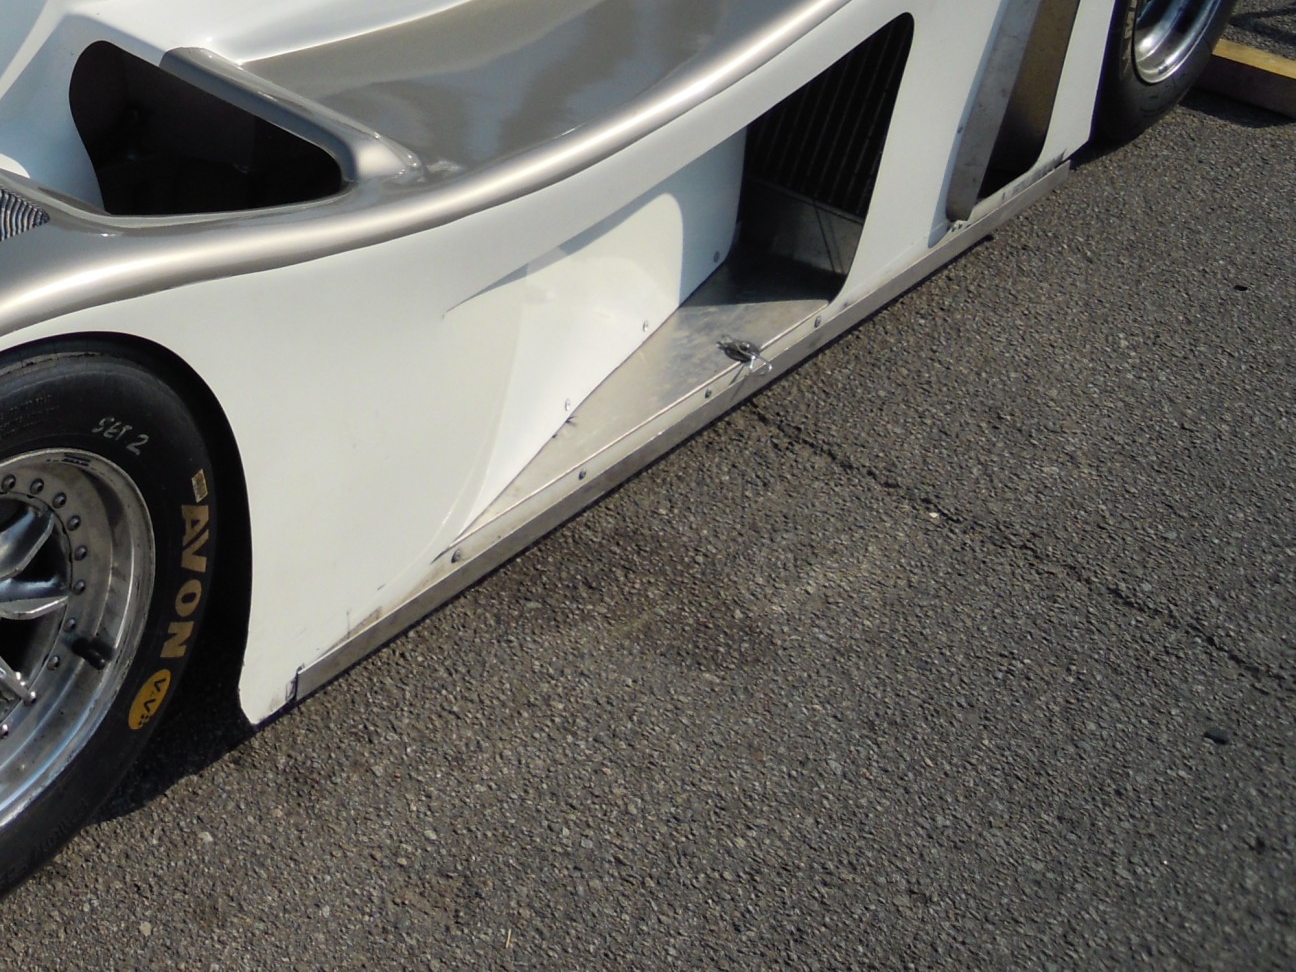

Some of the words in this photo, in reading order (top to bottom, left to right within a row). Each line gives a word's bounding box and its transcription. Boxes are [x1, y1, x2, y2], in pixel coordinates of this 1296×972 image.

[91, 417, 133, 441] SET
[125, 434, 150, 456] 2
[160, 504, 209, 658] AVON
